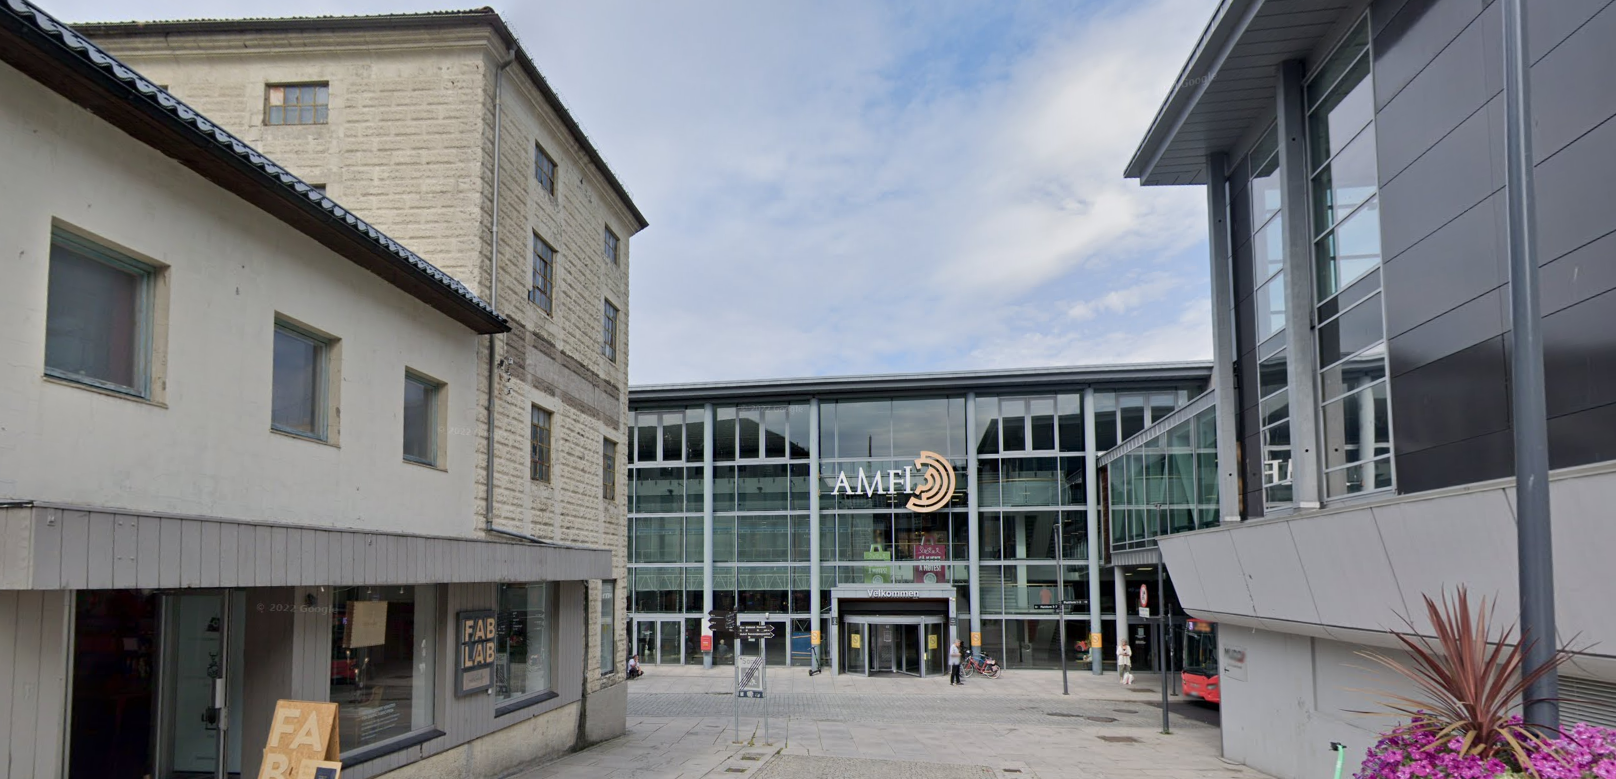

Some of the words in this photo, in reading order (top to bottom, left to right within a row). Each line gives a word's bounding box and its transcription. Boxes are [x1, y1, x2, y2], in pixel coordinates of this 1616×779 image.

[830, 465, 914, 498] AMFI
[867, 589, 919, 598] Velkommen
[463, 617, 496, 642] FAB
[463, 641, 496, 668] LAB
[270, 707, 322, 752] FA
